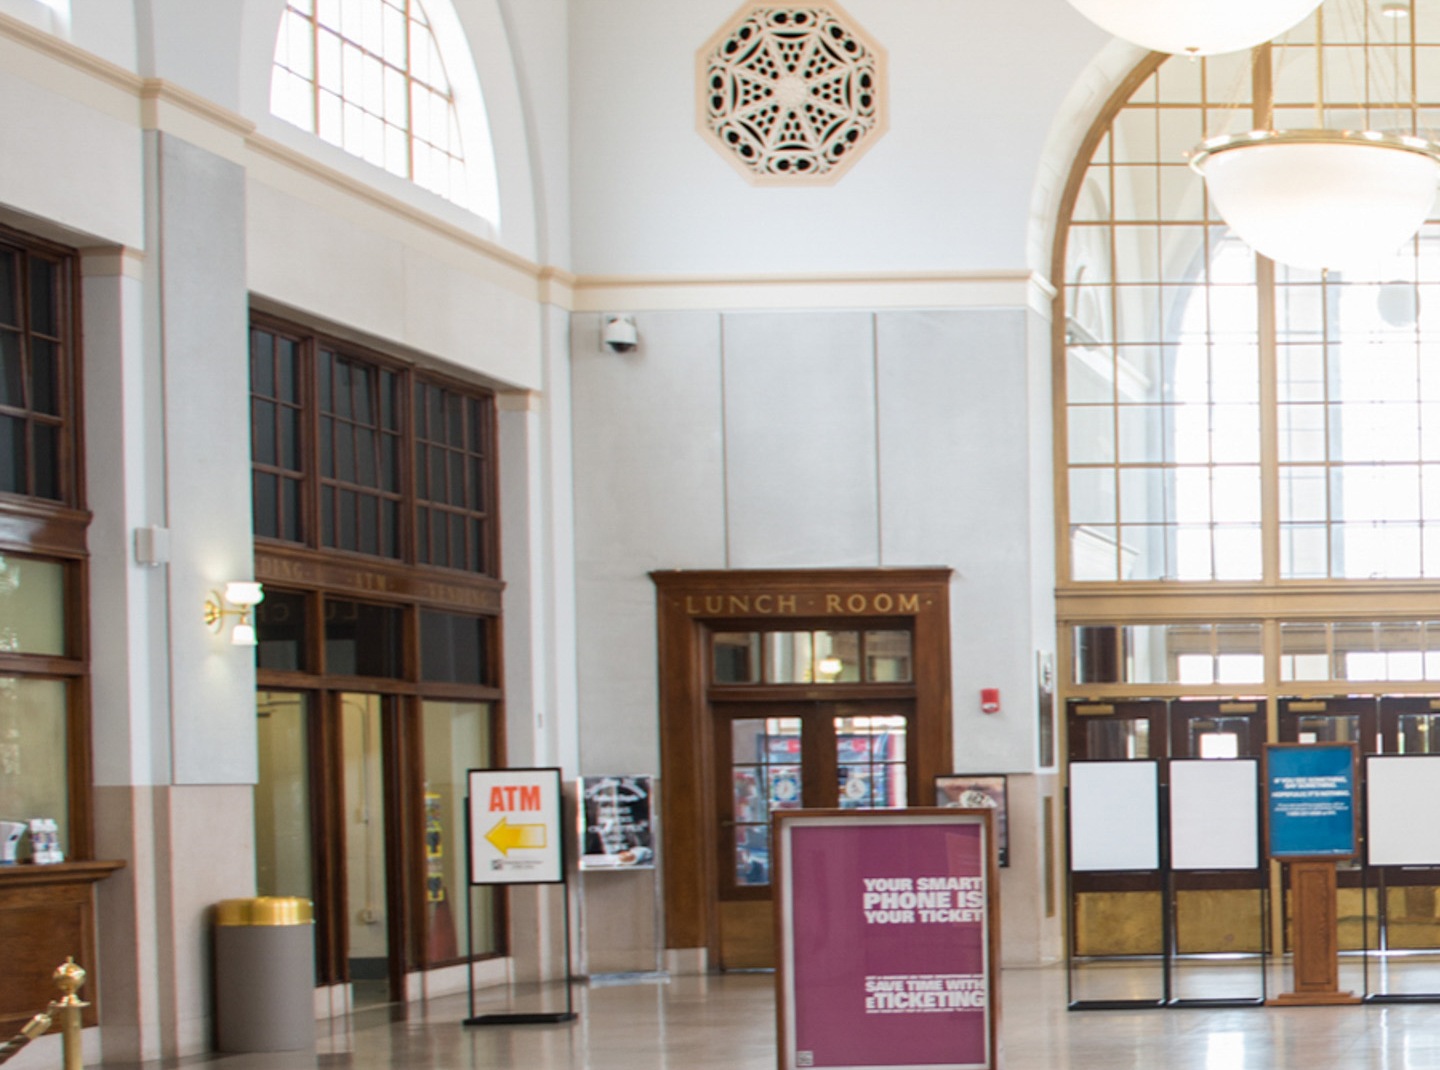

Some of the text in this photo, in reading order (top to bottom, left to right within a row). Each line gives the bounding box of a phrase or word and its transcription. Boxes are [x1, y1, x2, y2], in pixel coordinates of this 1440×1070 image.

[686, 593, 920, 614] LUNCH ROOM
[489, 785, 541, 812] ATM
[863, 876, 982, 892] YOUR SMART
[863, 890, 983, 910] PHONE IS
[864, 908, 983, 923] YOUR TICKET
[865, 980, 905, 992] SAVE
[906, 979, 944, 991] TIME
